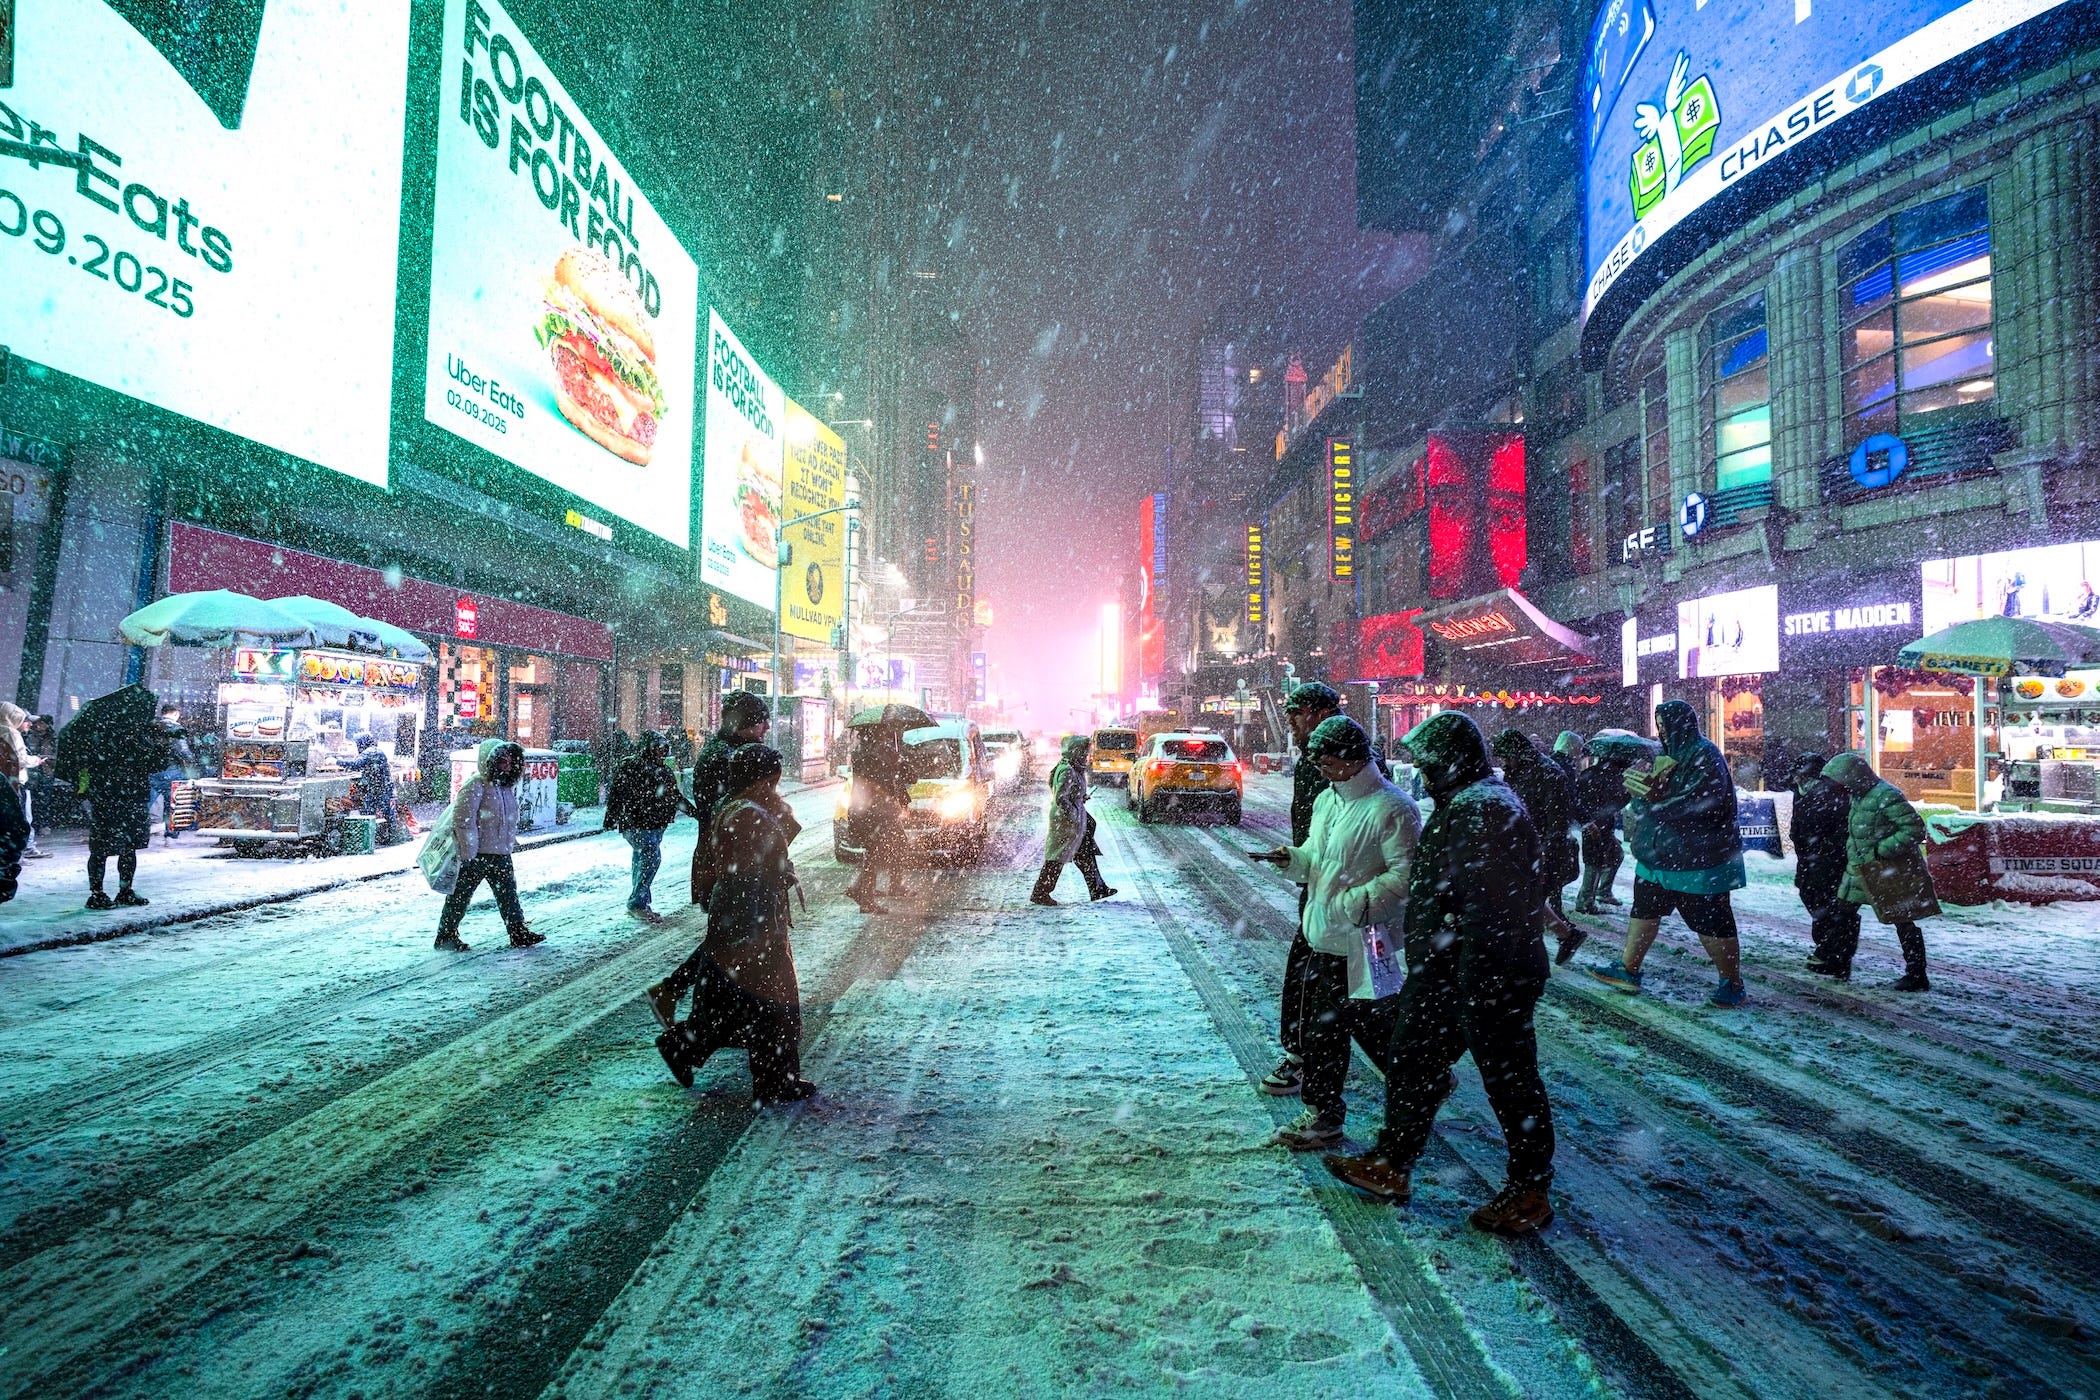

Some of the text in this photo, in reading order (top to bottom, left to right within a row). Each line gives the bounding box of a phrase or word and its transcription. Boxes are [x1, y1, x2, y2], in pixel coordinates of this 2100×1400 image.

[463, 0, 639, 252] FOOTBALL
[1720, 88, 1836, 182] CHASE
[76, 132, 234, 274] Eats
[460, 57, 660, 319] IS FOR FOOD
[1592, 241, 1629, 300] CHASE
[447, 352, 526, 420] Uber Eats
[447, 388, 508, 435] 02.09.2025
[713, 358, 774, 441] IS FOR FOOD
[714, 329, 766, 412] FOOTBALL
[1333, 442, 1352, 576] NEW VICTORY
[956, 484, 973, 628] TUSSAUDS
[1248, 526, 1262, 622] NEW VICTORY
[789, 603, 837, 629] MULLVAD VPN
[1431, 611, 1517, 640] Subway
[1784, 602, 1911, 636] STEVE MADDEN
[1740, 826, 1779, 837] TIMES
[2002, 858, 2056, 871] TIMES
